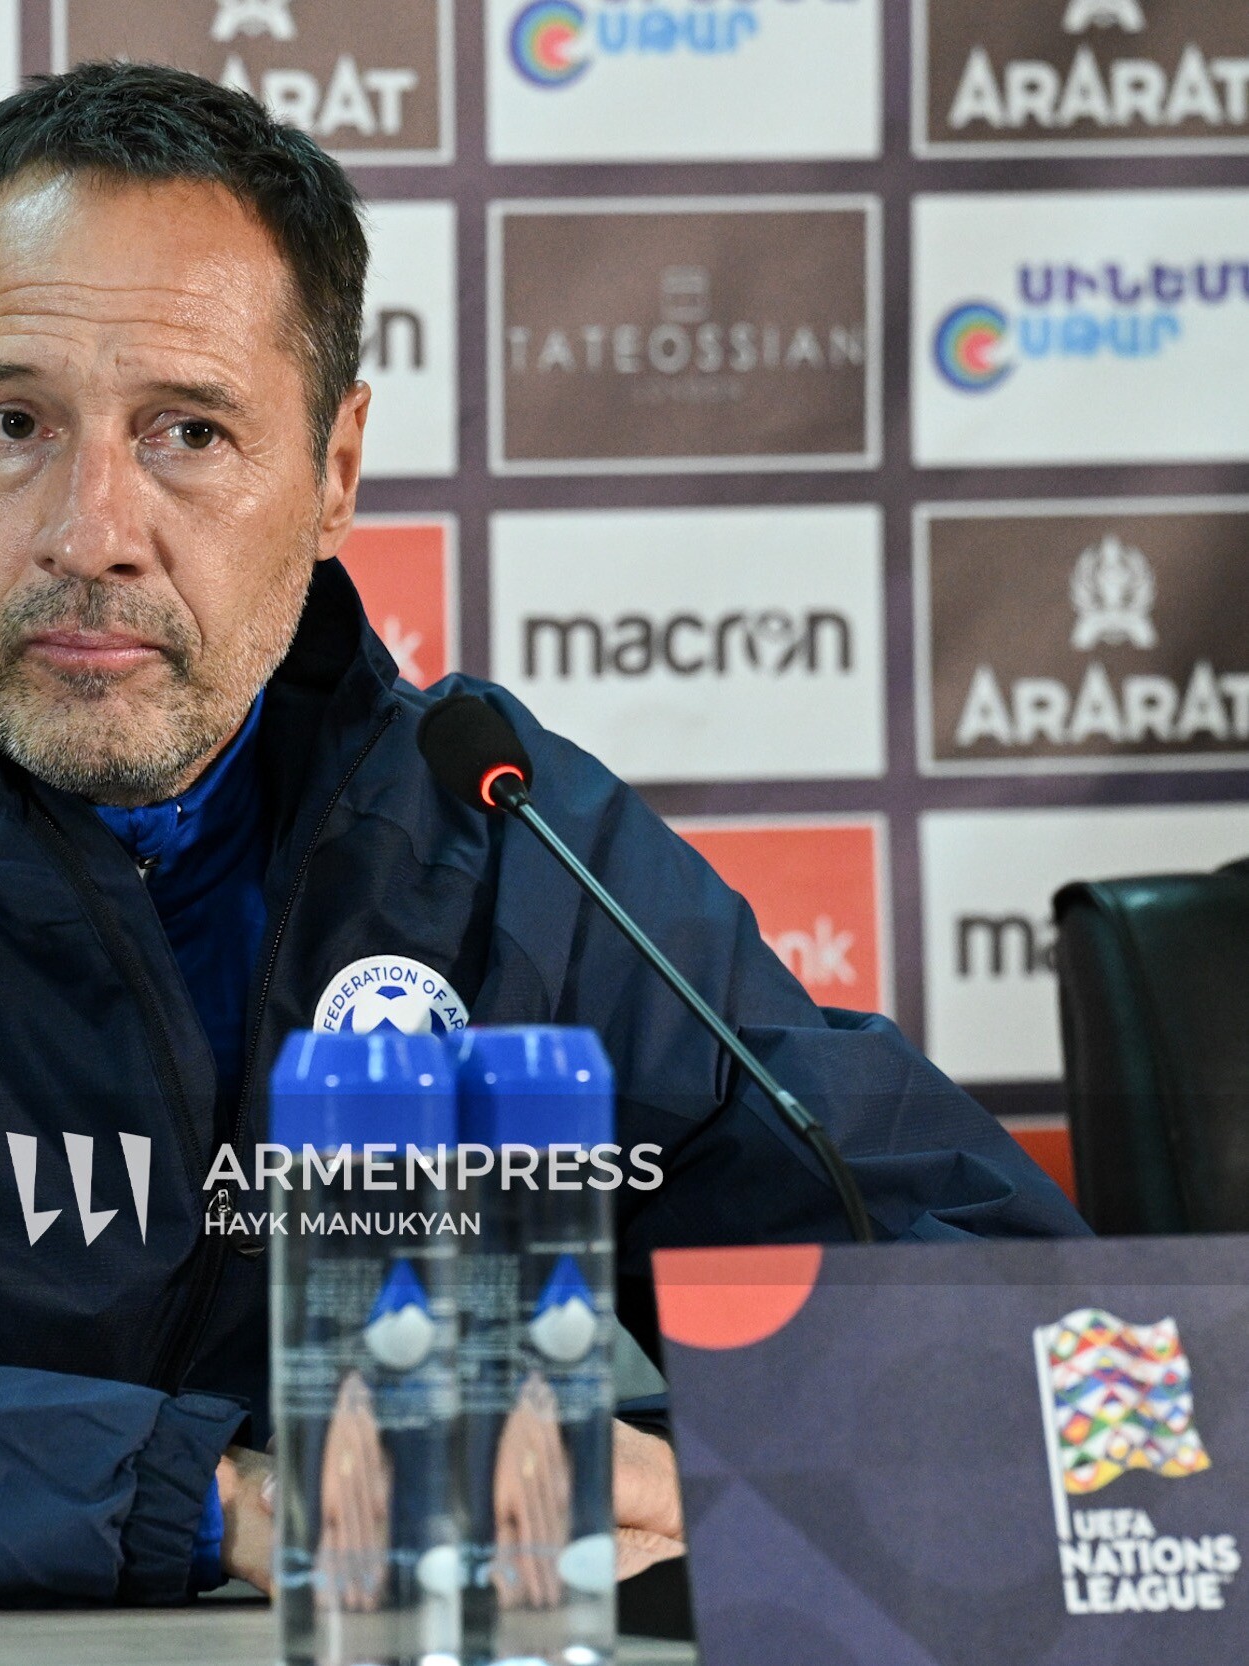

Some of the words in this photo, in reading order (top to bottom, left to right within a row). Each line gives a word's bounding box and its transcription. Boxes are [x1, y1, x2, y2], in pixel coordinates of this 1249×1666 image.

[507, 322, 866, 374] TATEOSSIAN
[522, 608, 853, 679] macron
[323, 966, 418, 1032] FEDERATION
[422, 979, 447, 1002] OF
[1072, 1508, 1156, 1541] UEFA
[1058, 1534, 1241, 1578] NATIONS
[1063, 1573, 1225, 1615] LEAGUE
